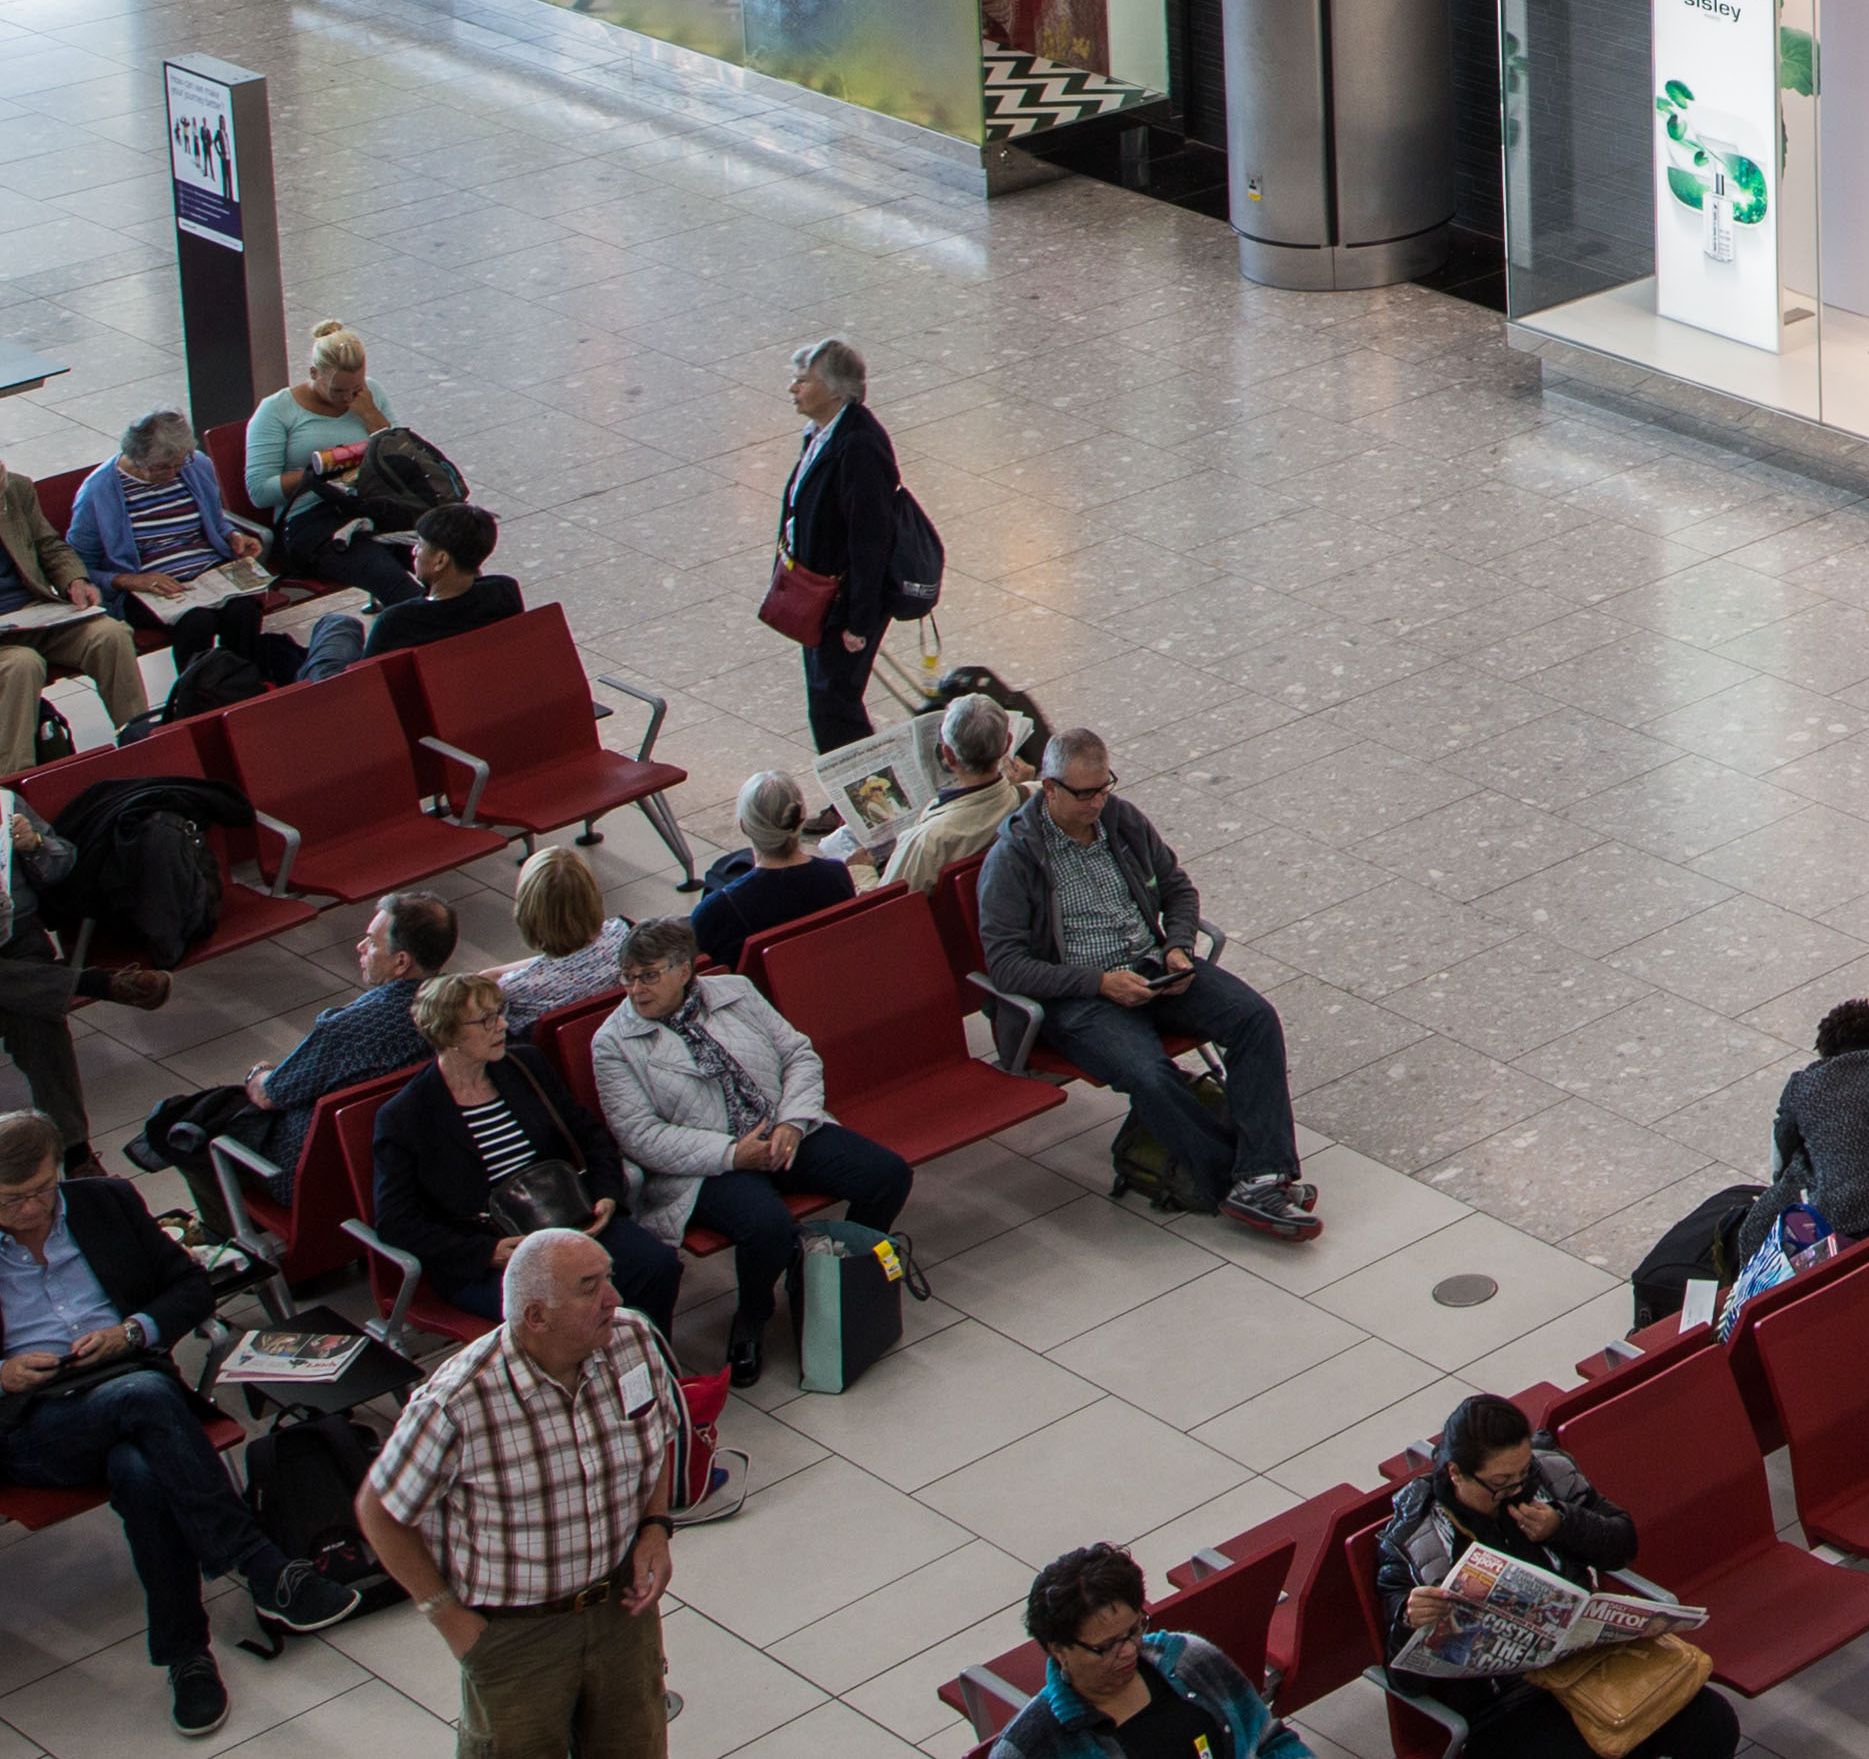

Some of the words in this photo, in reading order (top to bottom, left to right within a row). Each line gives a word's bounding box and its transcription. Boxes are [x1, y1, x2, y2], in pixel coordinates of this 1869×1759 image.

[1470, 1552, 1504, 1573] Sport
[1482, 1612, 1535, 1643] COSTA
[1583, 1600, 1650, 1629] Mirror
[1491, 1636, 1527, 1660] THE
